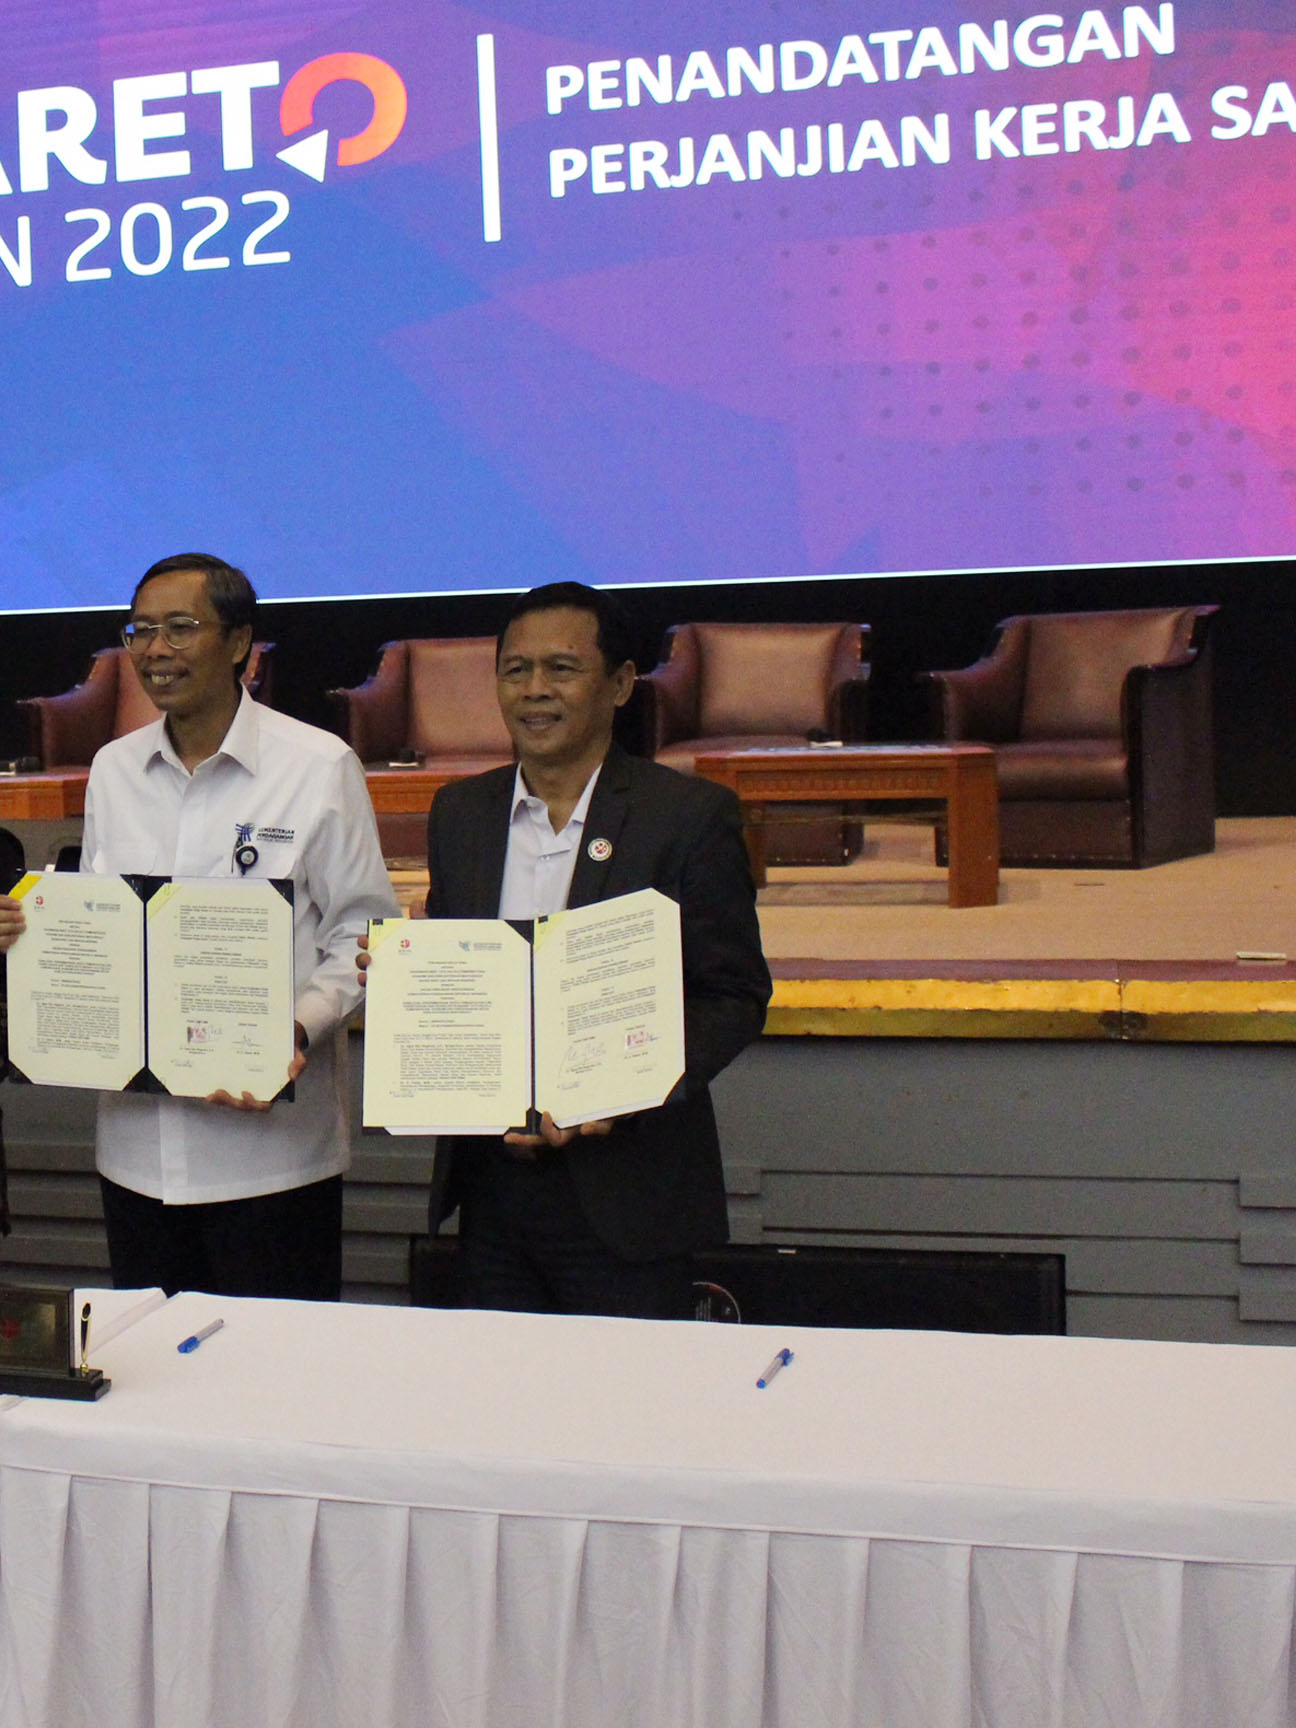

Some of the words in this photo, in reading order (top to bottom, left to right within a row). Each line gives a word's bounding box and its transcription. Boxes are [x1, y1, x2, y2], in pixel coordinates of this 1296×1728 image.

[546, 2, 1175, 115] PENANDATANGAN
[549, 113, 950, 198] PERJANJIAN
[975, 92, 1191, 160] KERJA
[65, 190, 292, 282] 2022
